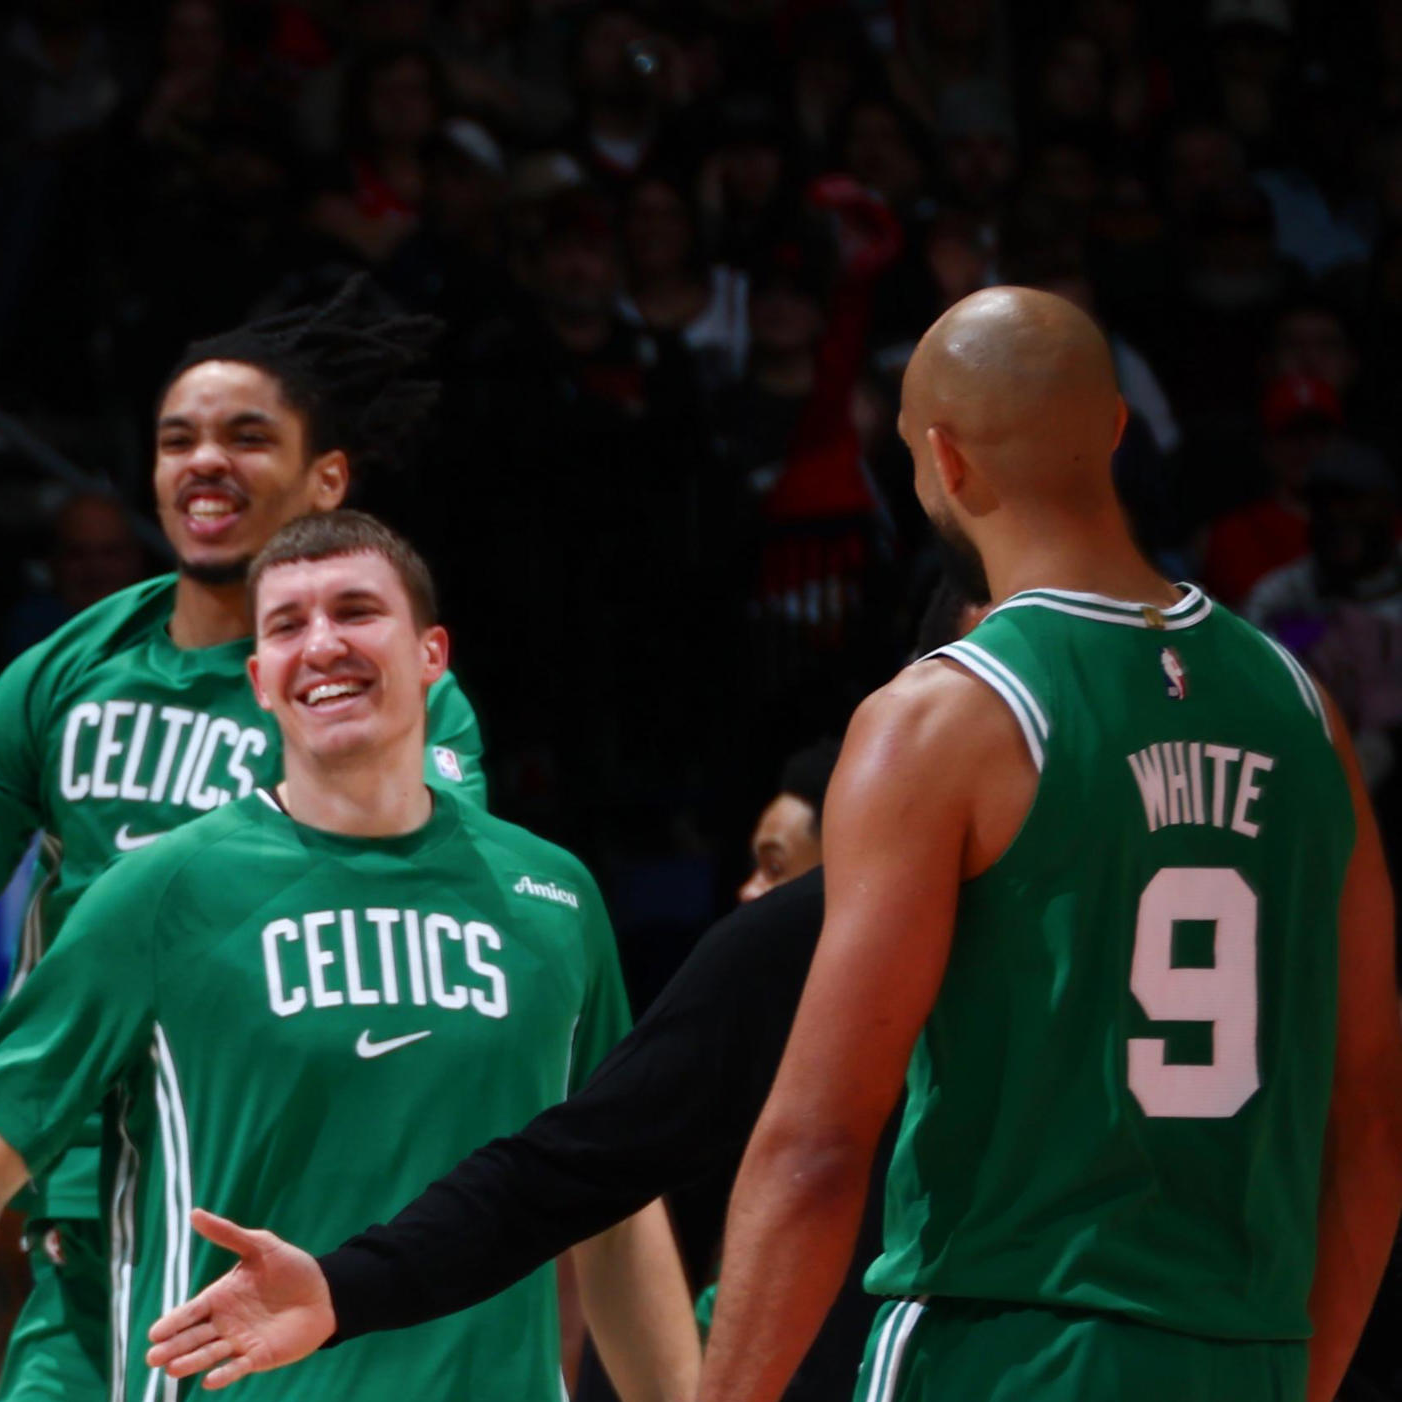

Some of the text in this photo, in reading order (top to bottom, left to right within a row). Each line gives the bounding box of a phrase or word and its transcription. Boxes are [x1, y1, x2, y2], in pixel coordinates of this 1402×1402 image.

[59, 699, 269, 812] CELTICS
[1127, 741, 1274, 838] WHITE
[260, 906, 510, 1020] CELTICS
[1127, 867, 1260, 1119] 9
